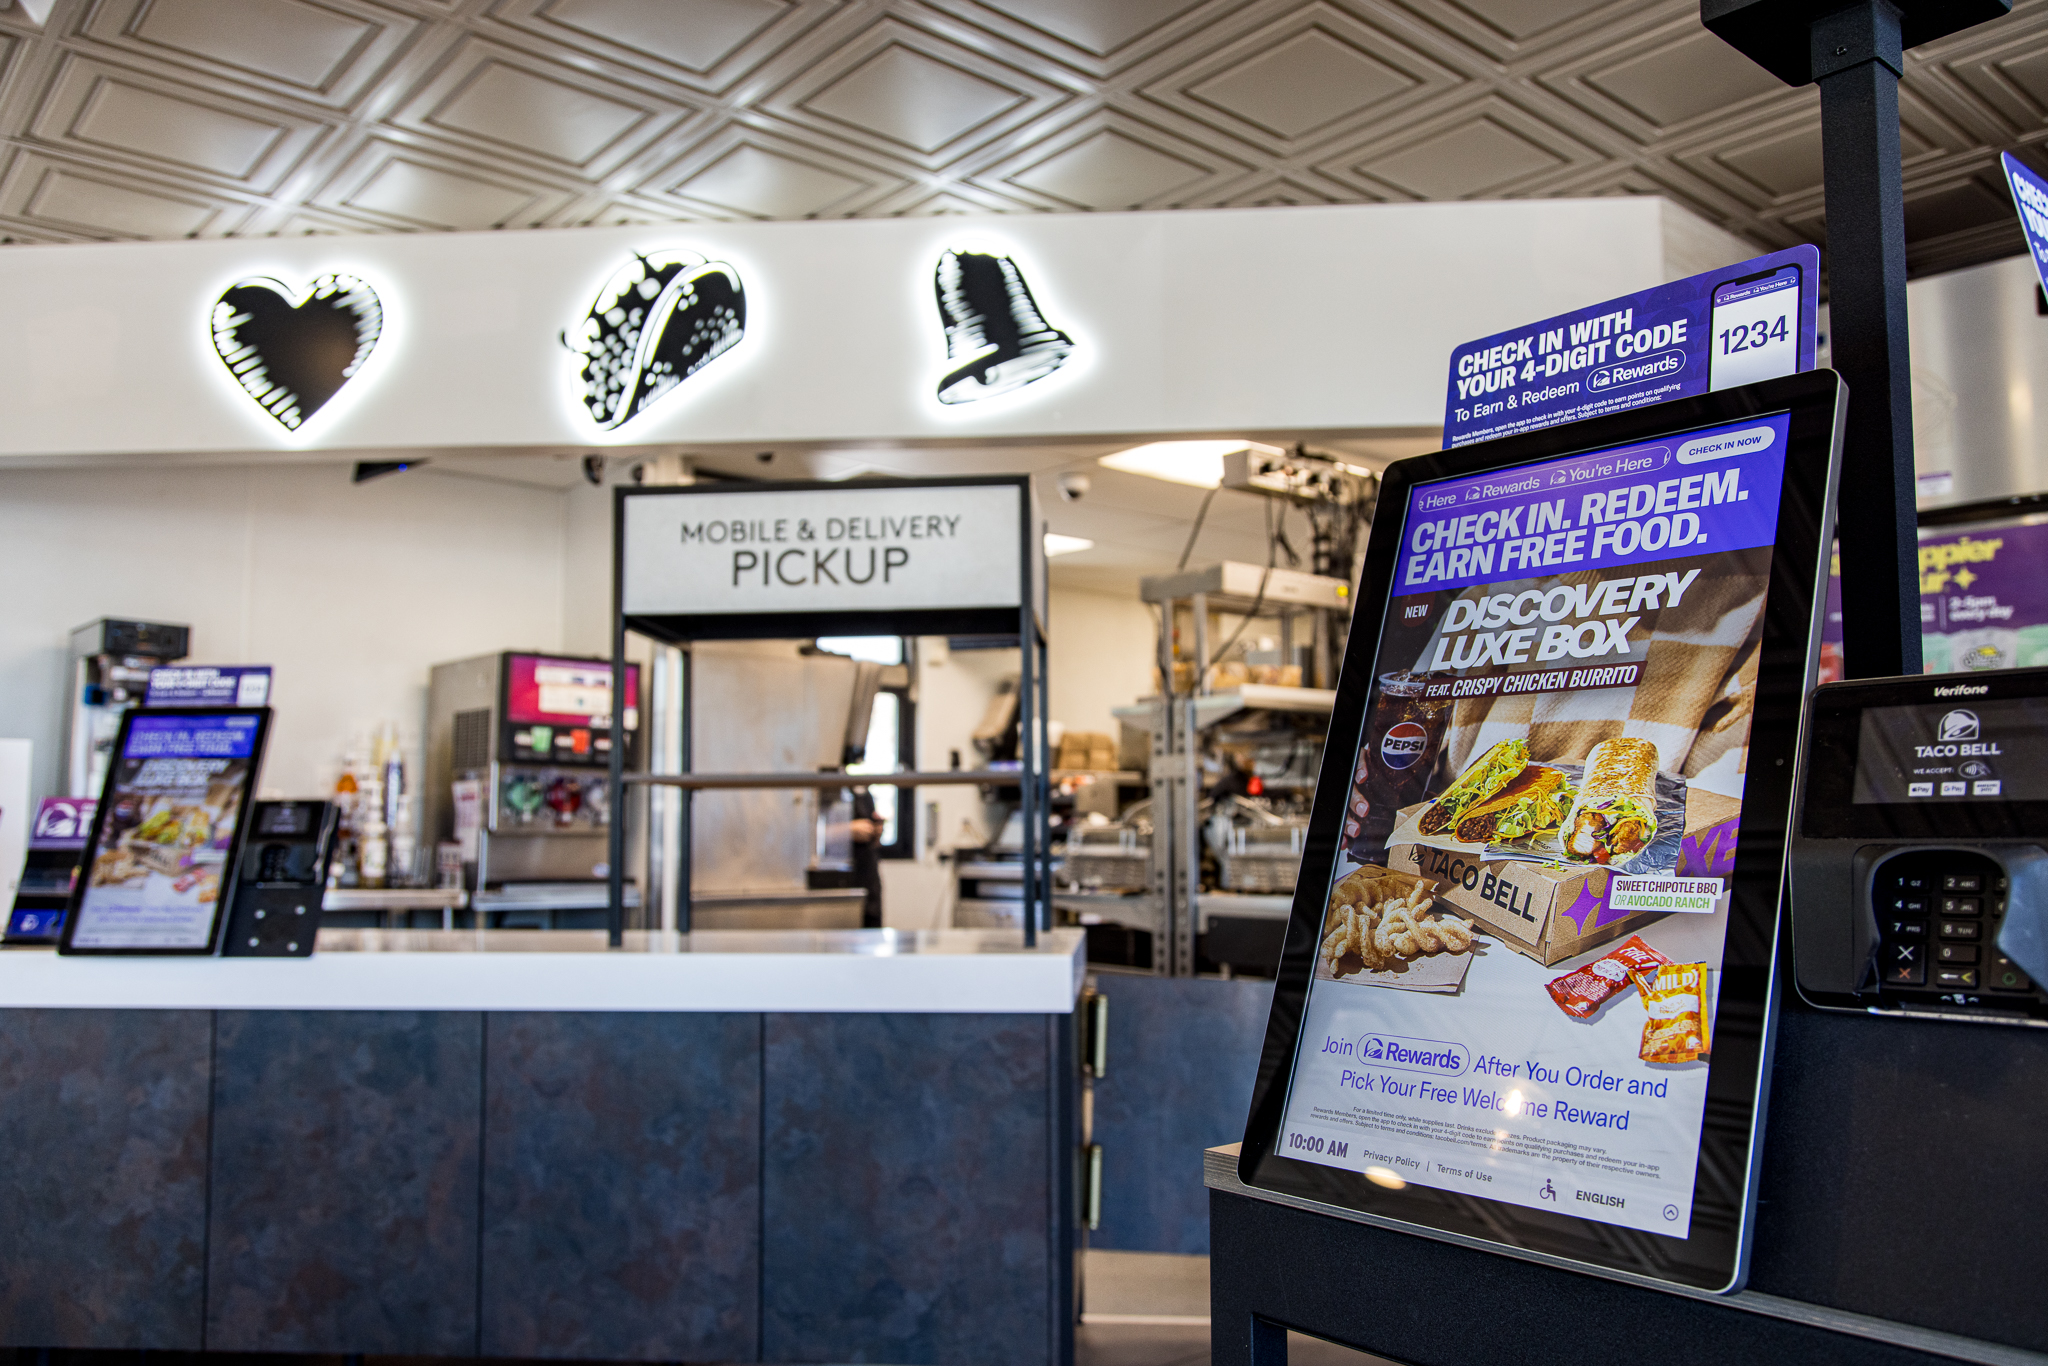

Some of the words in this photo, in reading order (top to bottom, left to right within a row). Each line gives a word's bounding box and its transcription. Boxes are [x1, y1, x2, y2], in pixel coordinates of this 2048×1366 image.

[1458, 336, 1534, 378] CHECK
[1538, 328, 1564, 356] IN
[1569, 308, 1633, 346] WITH
[1720, 314, 1789, 356] 1234
[1456, 364, 1518, 400] YOUR
[1520, 339, 1612, 382] 4-DIGIT
[1615, 319, 1688, 359] CODE
[1454, 408, 1470, 422] To
[1473, 399, 1504, 418] Earn
[1507, 395, 1518, 410] &
[1522, 381, 1580, 405] Redeem
[1613, 356, 1678, 383] Rewards
[1689, 443, 1722, 456] CHECK
[1724, 441, 1734, 450] IN
[1737, 436, 1762, 447] NOW
[1426, 494, 1456, 508] Here
[1482, 477, 1540, 498] Rewards
[1570, 466, 1612, 482] You're
[1616, 458, 1652, 474] Here
[1412, 506, 1525, 554] CHECK
[1526, 498, 1571, 534] IN.
[1579, 468, 1748, 526] REDEEM.
[681, 518, 790, 544] MOBILE
[798, 518, 816, 541] &
[826, 515, 961, 541] DELIVERY
[1405, 546, 1498, 586] EARN
[1499, 529, 1588, 573] FREE
[1591, 512, 1708, 559] FOOD.
[732, 547, 909, 587] PICKUP
[1404, 605, 1428, 619] NEW
[1441, 569, 1701, 633] DISCOVERY
[1430, 628, 1538, 671] LUXE
[1536, 617, 1640, 661] BOX
[1425, 683, 1449, 697] FEAT.
[1451, 676, 1503, 697] CRISPY
[1503, 671, 1570, 693] CHICKEN
[1568, 665, 1638, 688] BURRITO
[1934, 684, 1988, 697] Verifone
[1384, 738, 1424, 752] PEPSI
[1914, 745, 1957, 758] TACO
[1960, 743, 2001, 756] BELL
[1430, 848, 1479, 891] TACO
[1480, 872, 1536, 923] BELL
[1616, 880, 1648, 892] SWEET
[1648, 882, 1694, 893] CHIPOTLE
[1696, 882, 1718, 895] BBQ
[1947, 878, 1956, 887] 2
[1614, 895, 1627, 906] OR
[1627, 896, 1672, 907] AVOCADO
[1675, 897, 1710, 908] RANCH
[1895, 900, 1903, 909] 4
[1322, 1036, 1352, 1056] Join
[1386, 1042, 1460, 1069] Rewards
[1473, 1055, 1520, 1078] After
[1526, 1061, 1559, 1084] You
[1566, 1066, 1624, 1091] Order
[1627, 1078, 1668, 1098] and
[1340, 1070, 1375, 1091] Pick
[1380, 1075, 1417, 1097] Your
[1419, 1081, 1457, 1104] Free
[1463, 1087, 1548, 1118] Welcme
[1554, 1100, 1630, 1130] Reward
[1289, 1132, 1324, 1153] 10:00
[1327, 1140, 1349, 1158] AM
[1364, 1150, 1393, 1164] Privacy
[1395, 1155, 1420, 1169] Policy
[1437, 1163, 1462, 1176] Terms
[1465, 1169, 1474, 1178] of
[1476, 1171, 1493, 1182] Use
[1576, 1190, 1625, 1208] ENGLISH
